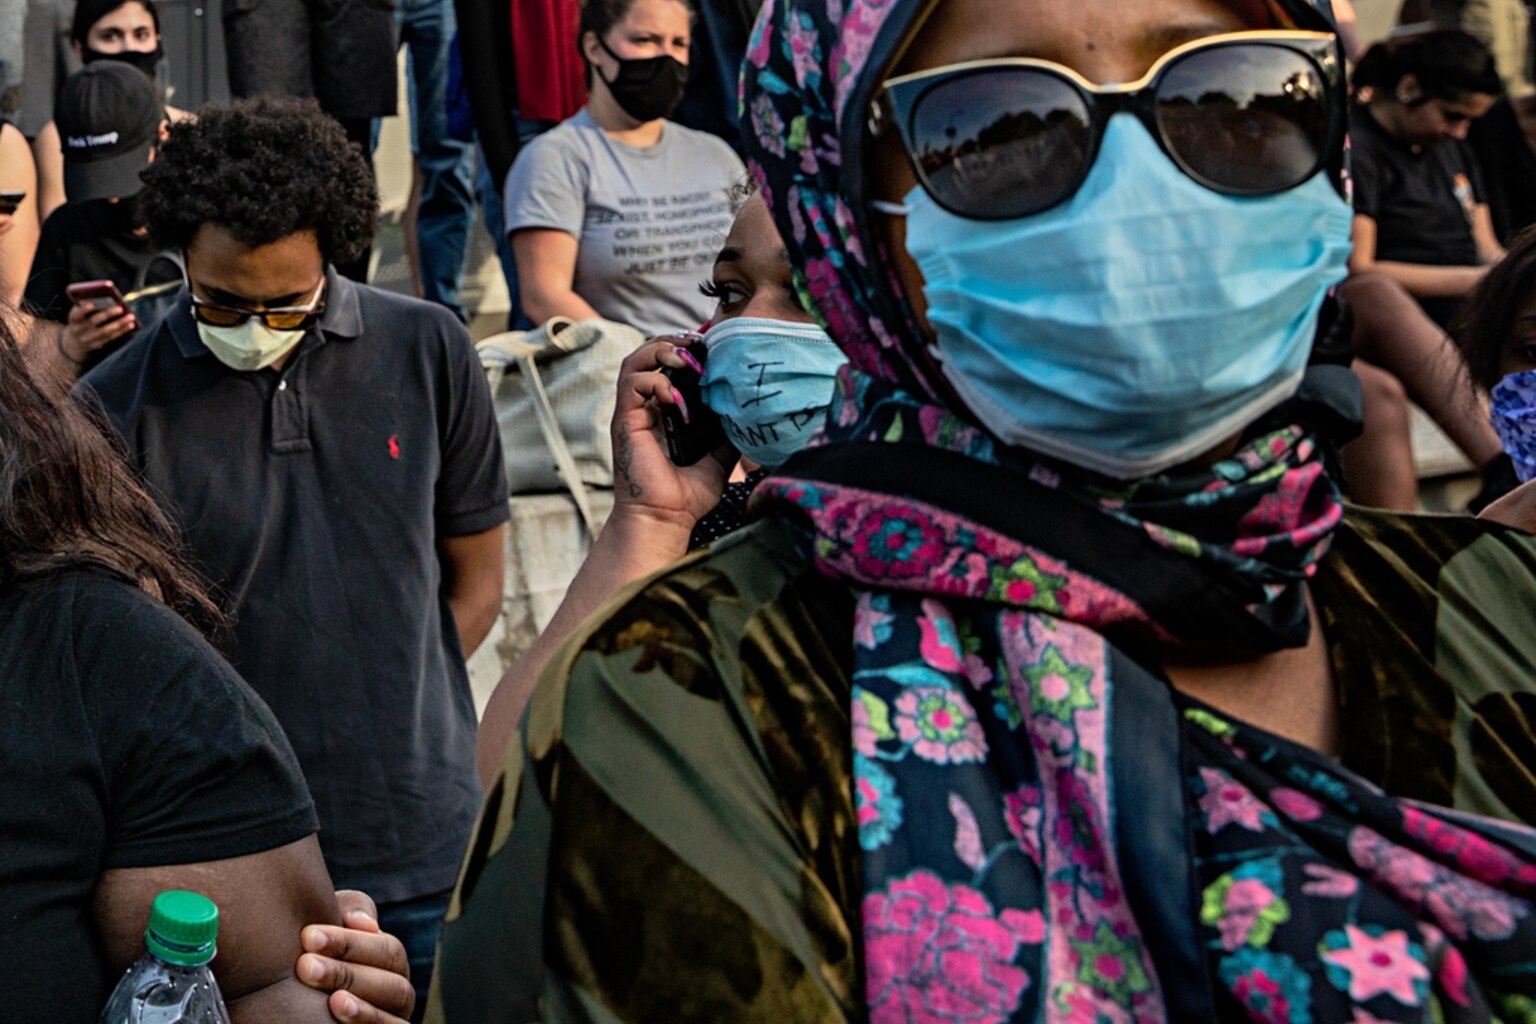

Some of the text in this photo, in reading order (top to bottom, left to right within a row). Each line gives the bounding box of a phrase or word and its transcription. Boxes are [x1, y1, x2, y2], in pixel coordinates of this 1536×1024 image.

[614, 227, 639, 240] OR
[613, 244, 663, 257] WHEN
[624, 259, 665, 274] JUST
[741, 360, 785, 408] I
